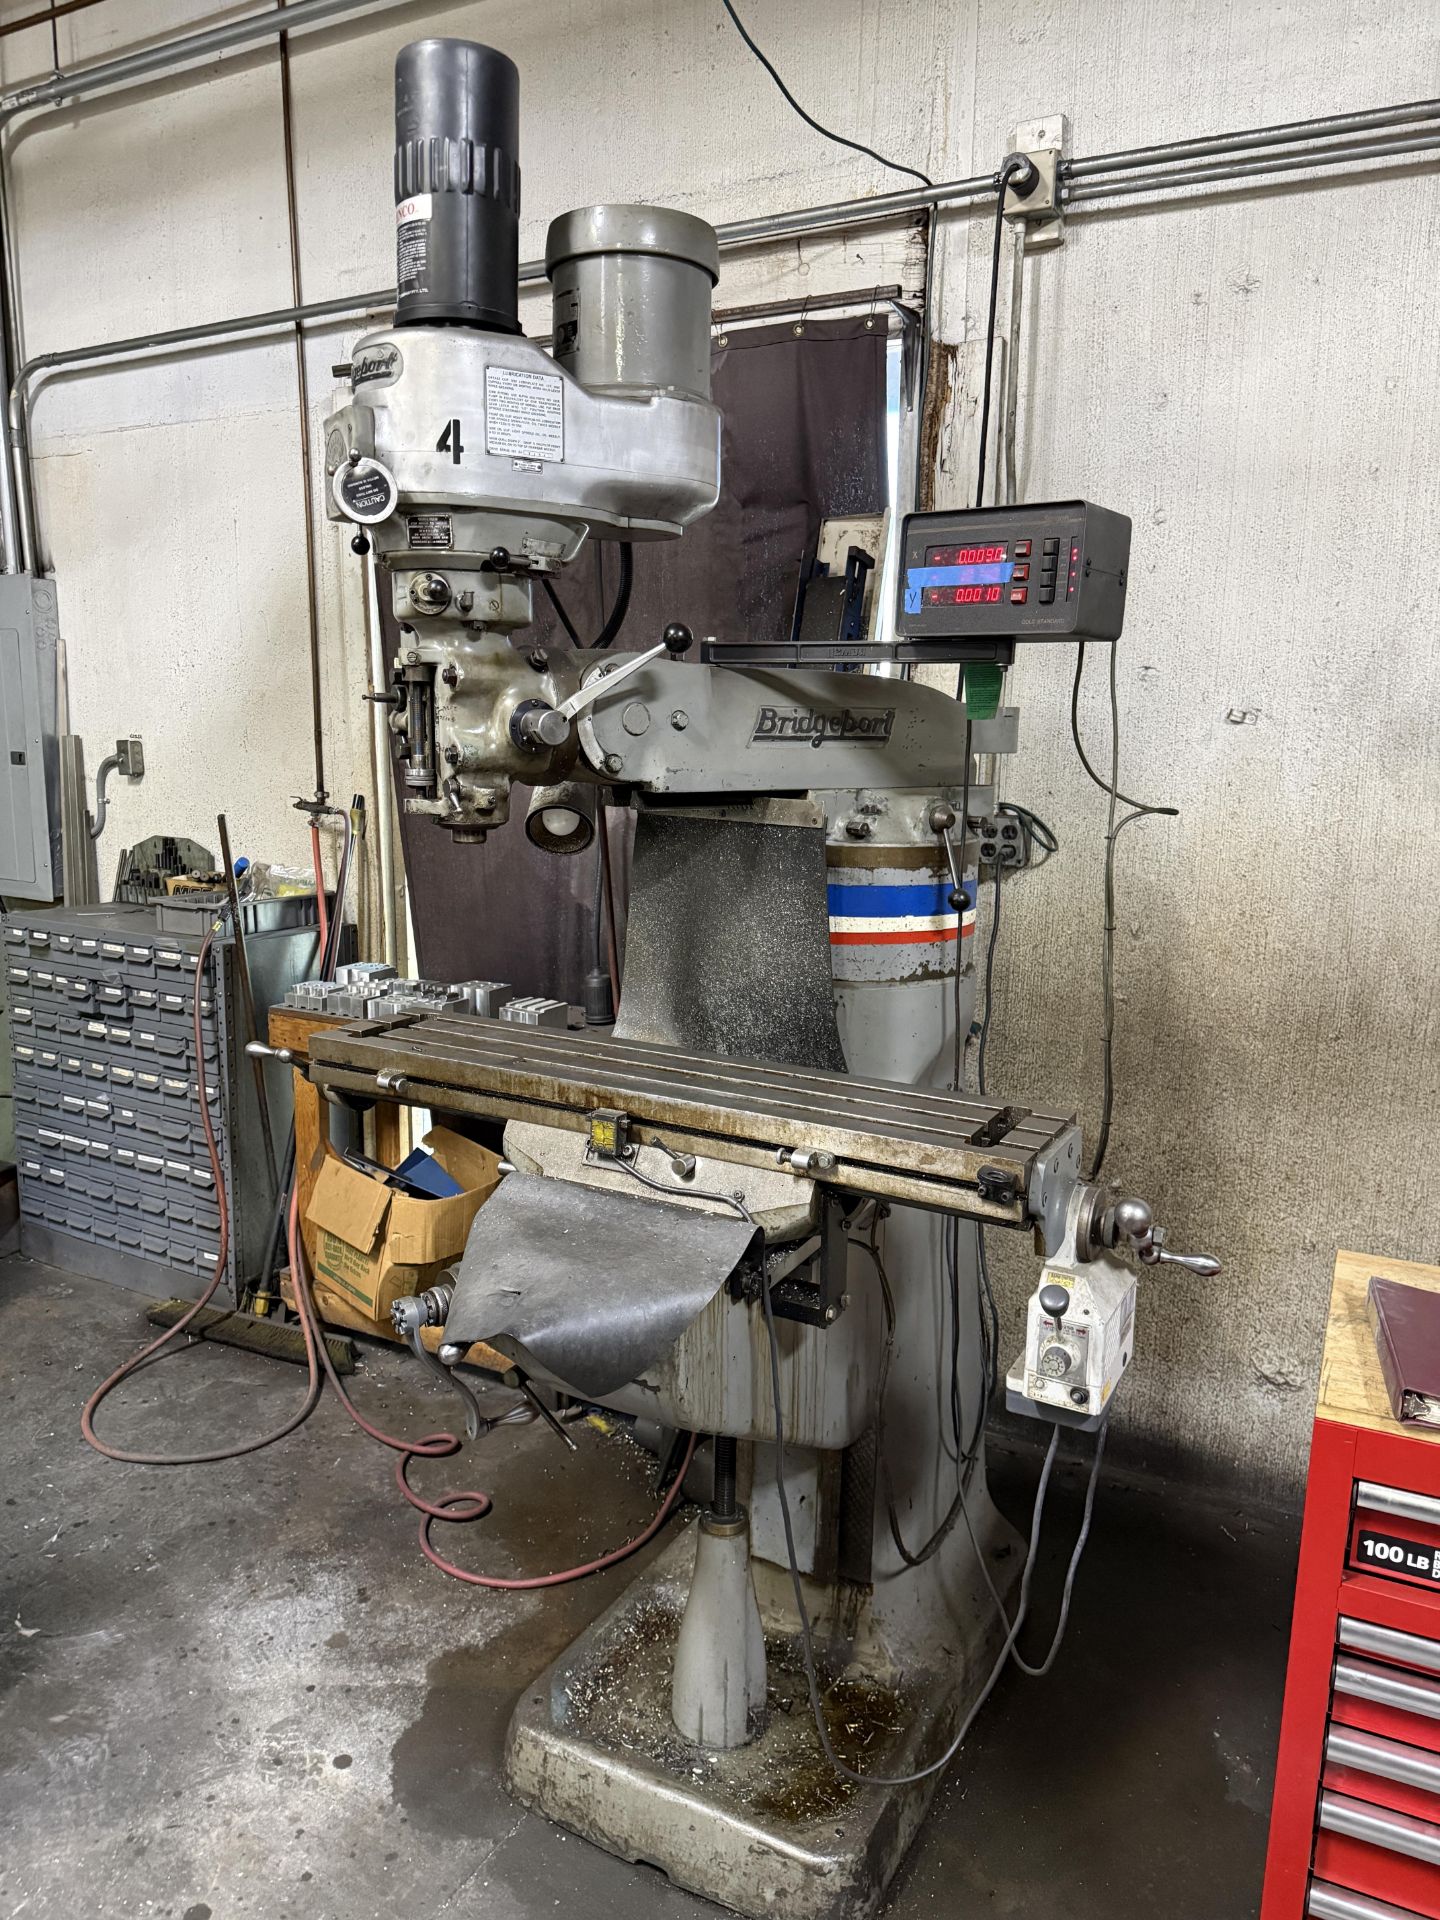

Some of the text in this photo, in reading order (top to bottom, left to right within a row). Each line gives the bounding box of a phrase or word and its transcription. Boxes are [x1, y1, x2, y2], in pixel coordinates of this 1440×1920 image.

[396, 202, 415, 224] NCO
[502, 370, 532, 379] LUBRICATION
[435, 418, 464, 465] 4
[356, 495, 386, 508] CAUTION
[754, 707, 896, 749] Bridgeport
[1363, 1539, 1430, 1570] 100 LB
